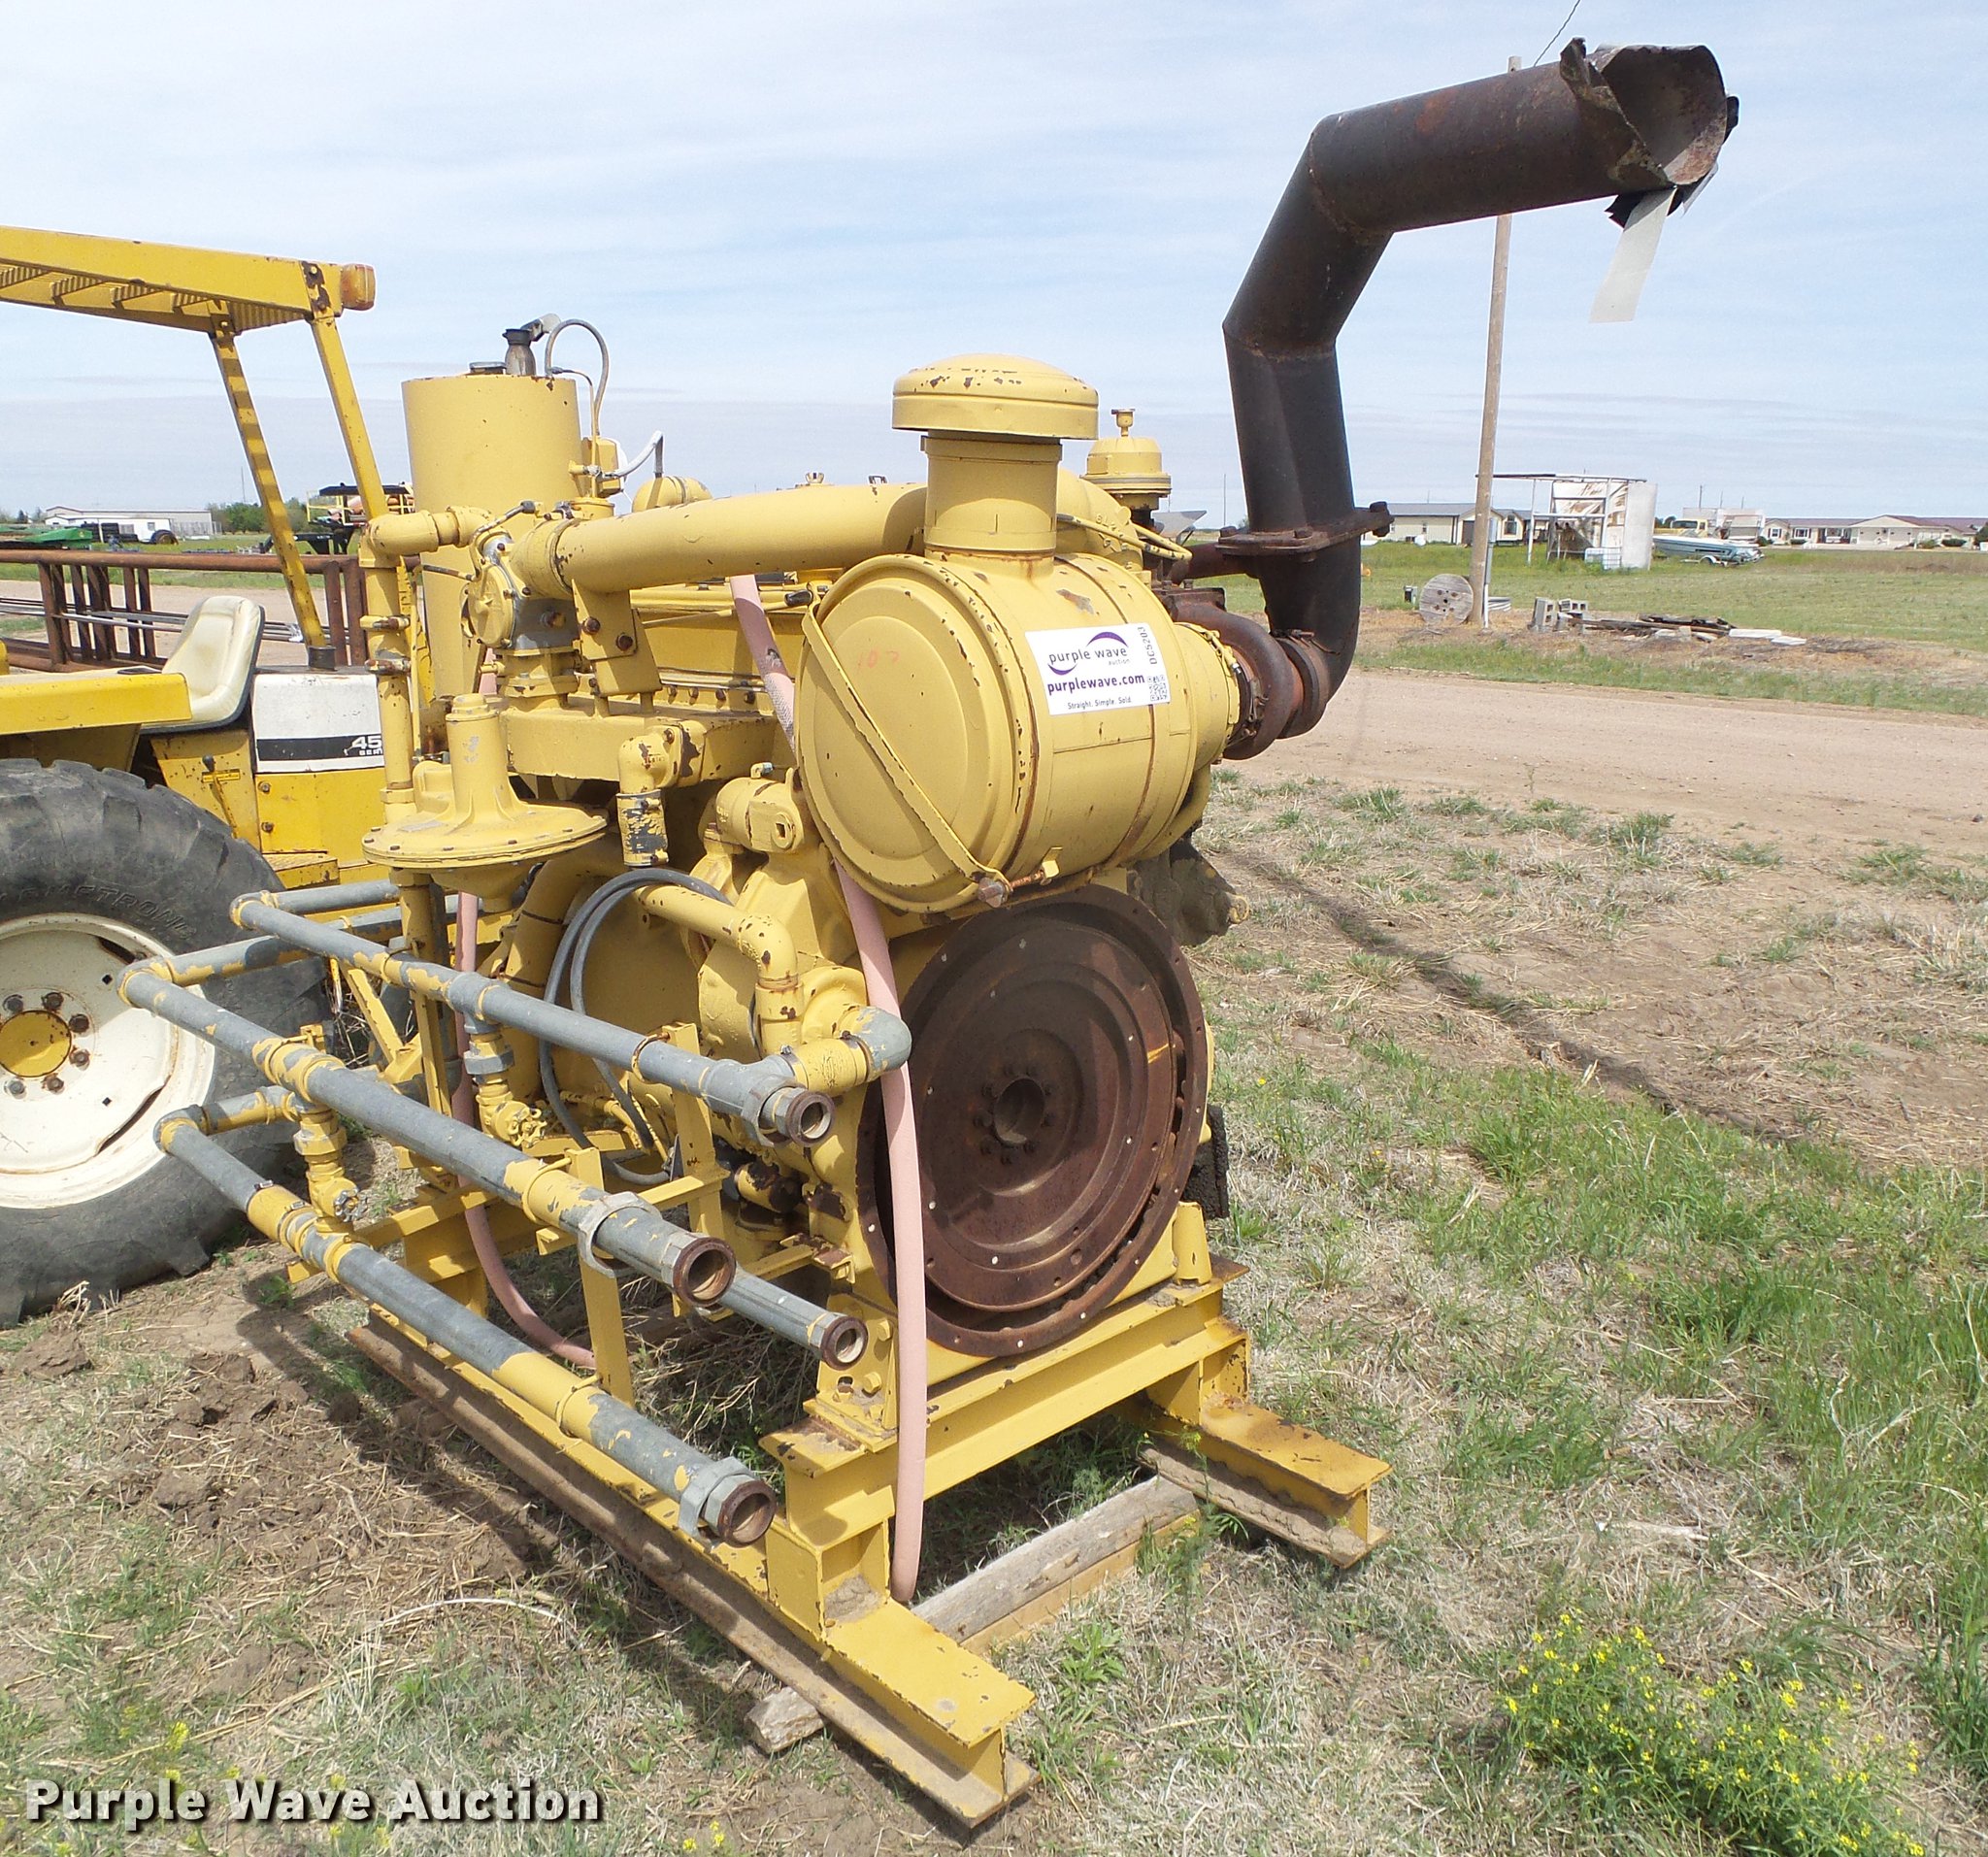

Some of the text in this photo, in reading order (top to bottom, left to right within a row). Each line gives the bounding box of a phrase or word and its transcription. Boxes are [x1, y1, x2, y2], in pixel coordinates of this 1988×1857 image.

[1048, 647, 1128, 665] purple wave
[1047, 674, 1145, 696] purplewave.com
